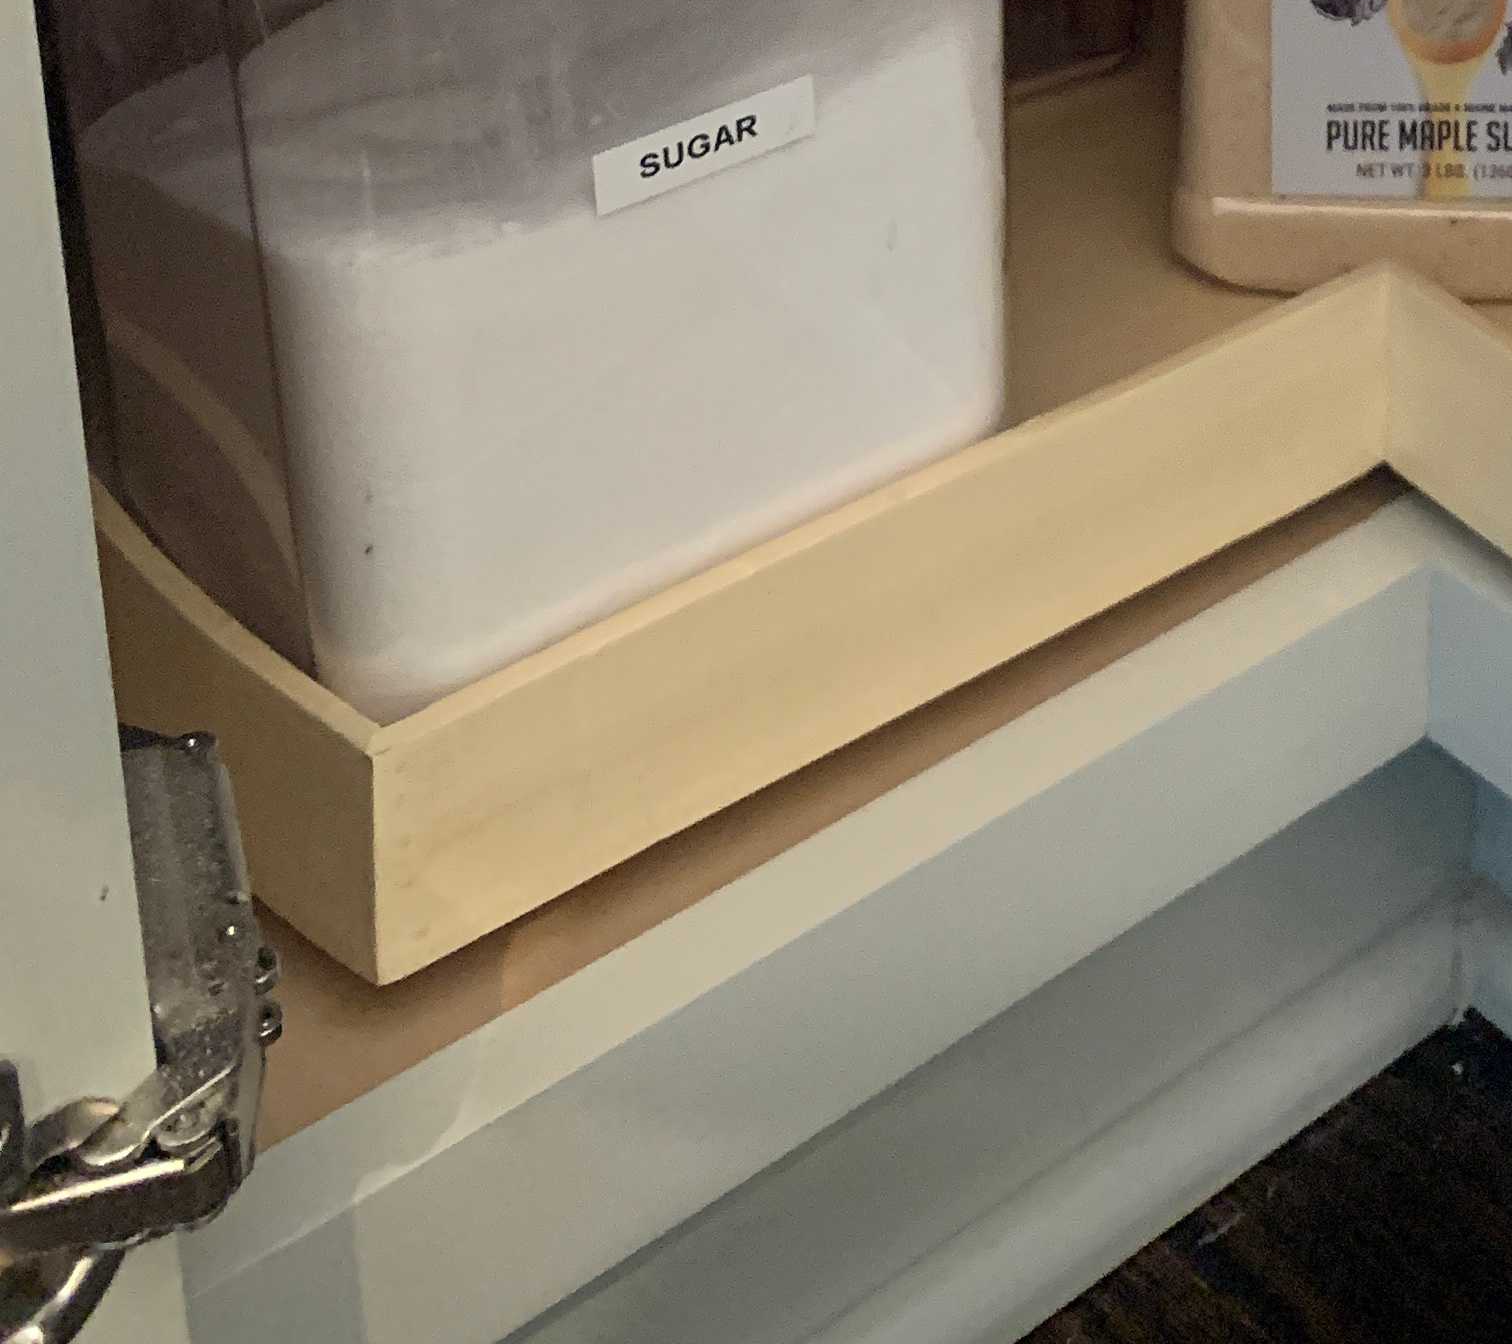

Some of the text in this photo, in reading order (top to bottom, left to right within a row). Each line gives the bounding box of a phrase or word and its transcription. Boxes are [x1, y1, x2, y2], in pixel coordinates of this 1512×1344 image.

[639, 113, 760, 180] SUGAR
[1326, 119, 1390, 153] PURE
[1398, 119, 1479, 153] MAPLE
[1356, 162, 1385, 179] NET
